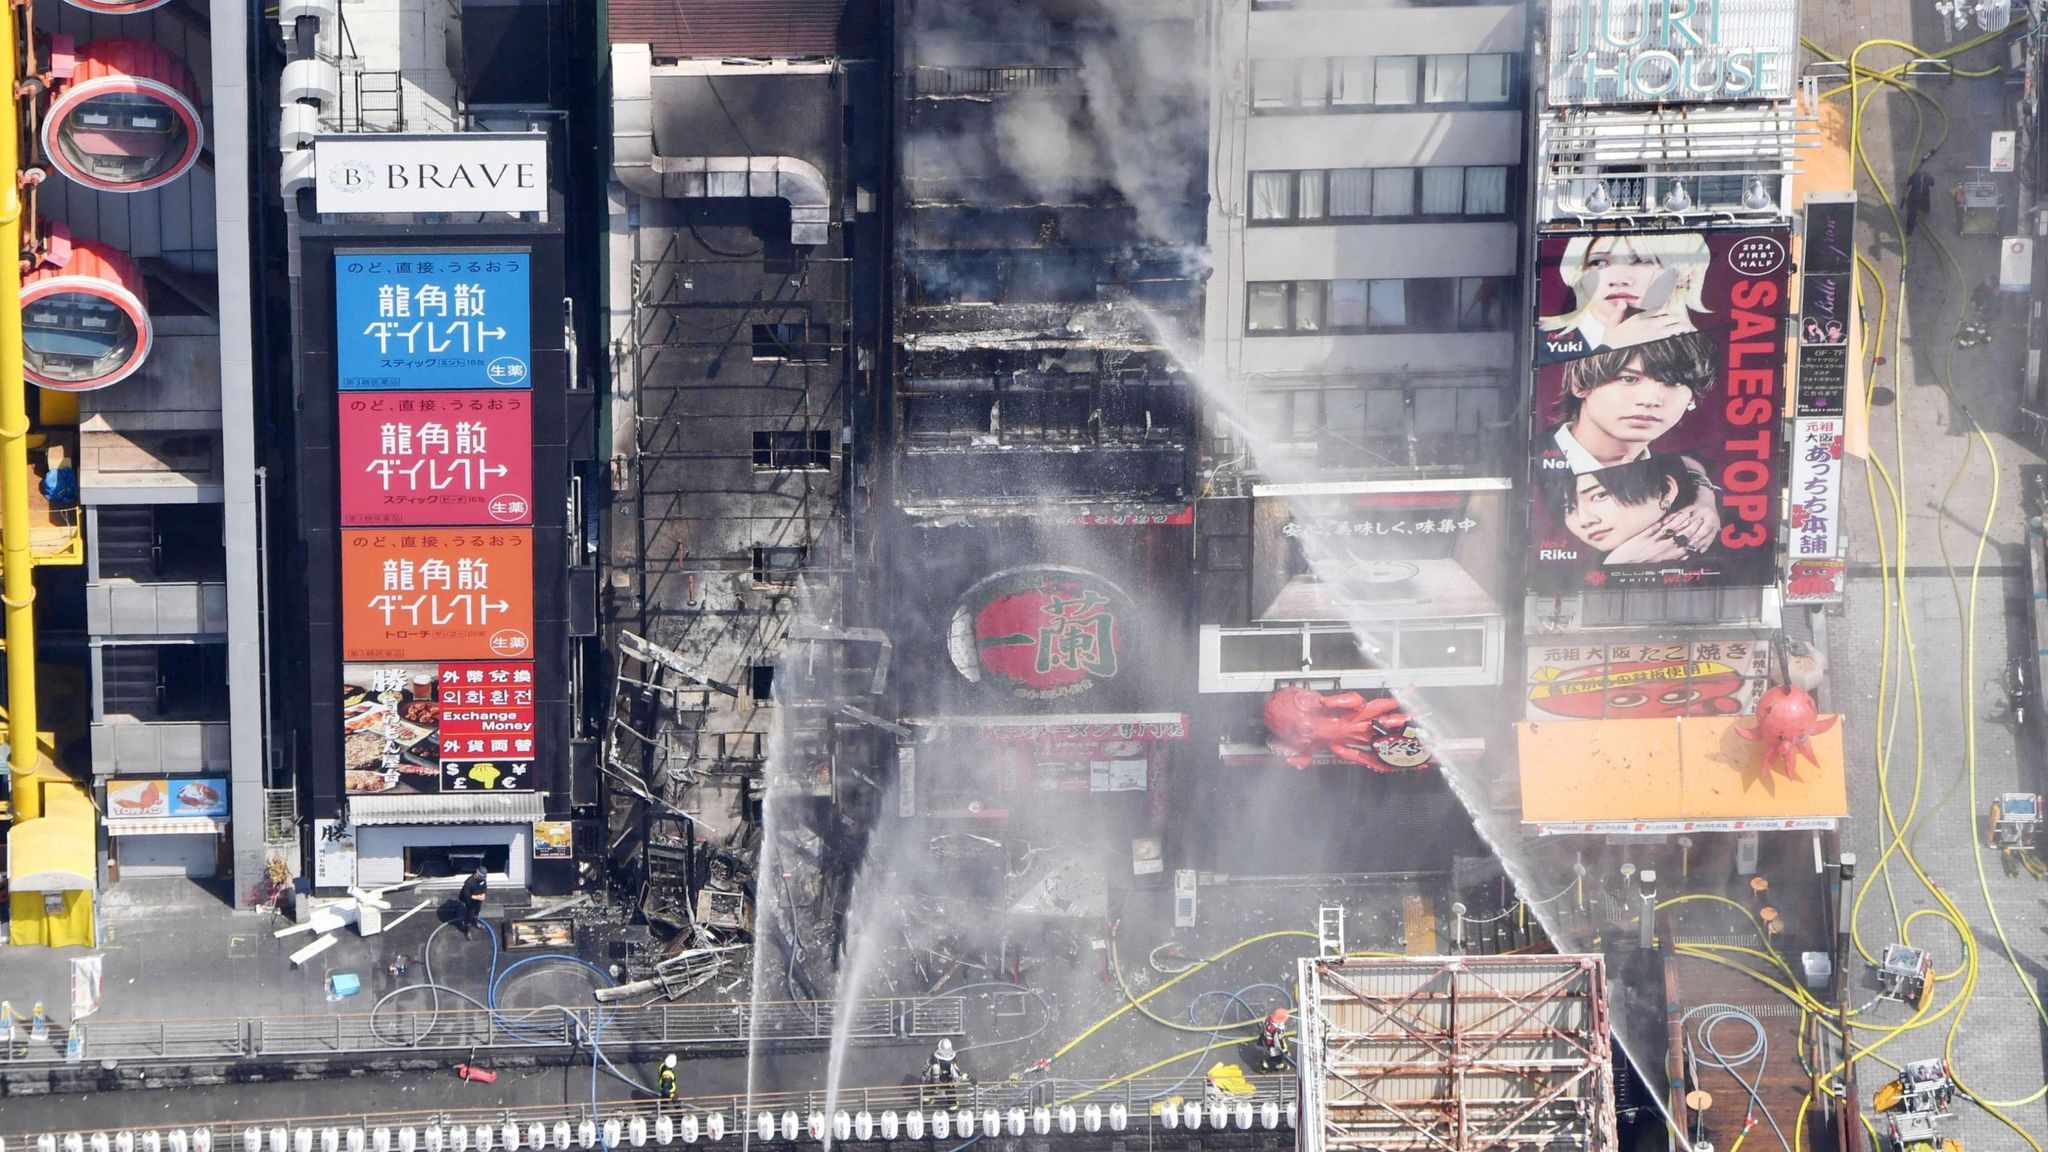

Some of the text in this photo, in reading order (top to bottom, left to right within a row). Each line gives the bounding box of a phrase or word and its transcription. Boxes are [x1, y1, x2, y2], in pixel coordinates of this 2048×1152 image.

[1586, 47, 1779, 97] HOUSE
[387, 163, 535, 190] BRAVE
[1743, 243, 1771, 251] 2024
[1738, 251, 1775, 259] FIRST
[347, 260, 520, 274] のど、直接、うるおう
[1740, 260, 1772, 268] HALF
[378, 283, 486, 318] 龍角散
[363, 320, 507, 354] ダイレクト
[1546, 341, 1583, 353] Yuki
[490, 364, 525, 378] 生薬
[350, 398, 522, 412] のど、直接、うるおう
[1719, 278, 1778, 550] SALES TOP3
[1805, 421, 1834, 432] 元祖
[380, 421, 488, 455] 龍角散
[1804, 432, 1834, 443] 大阪
[365, 458, 508, 491] ダイレクト
[1800, 444, 1832, 554] あっちち本舗
[491, 502, 525, 514] 生薬
[353, 535, 523, 548] のど、直接、うるおう
[1540, 549, 1578, 561] Riku
[383, 557, 489, 591] 龍角散
[367, 593, 510, 626] ダイレクト
[976, 590, 1118, 678] 一蘭
[492, 636, 526, 649] 生薬
[1543, 643, 1747, 662] 元祖大阪たこ焼き
[371, 668, 408, 692] 勝
[443, 689, 532, 706] 외화환전
[442, 711, 518, 722] Exchange
[481, 721, 533, 733] Money
[443, 739, 533, 753] 外貨両替
